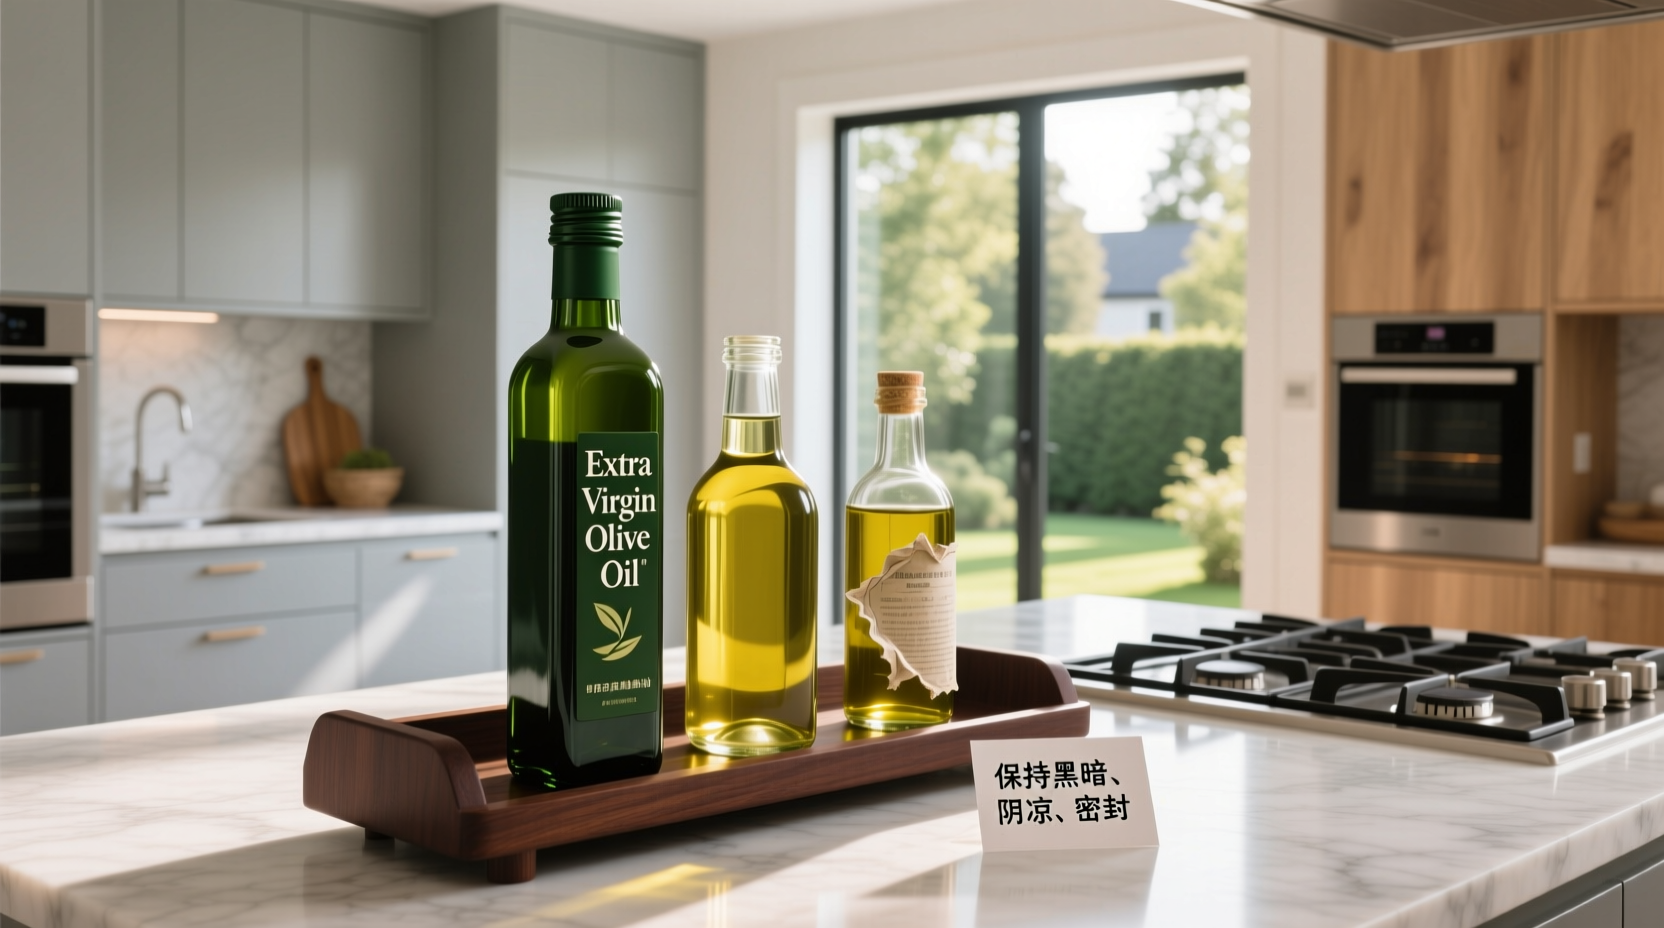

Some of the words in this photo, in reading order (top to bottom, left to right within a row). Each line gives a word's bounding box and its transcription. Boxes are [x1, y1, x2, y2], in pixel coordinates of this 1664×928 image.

[585, 450, 652, 477] Extra
[581, 487, 656, 522] Virgin
[585, 524, 650, 553] Olive
[994, 758, 1121, 790] 保持黑暗、
[997, 793, 1131, 826] 阴凉、密封
